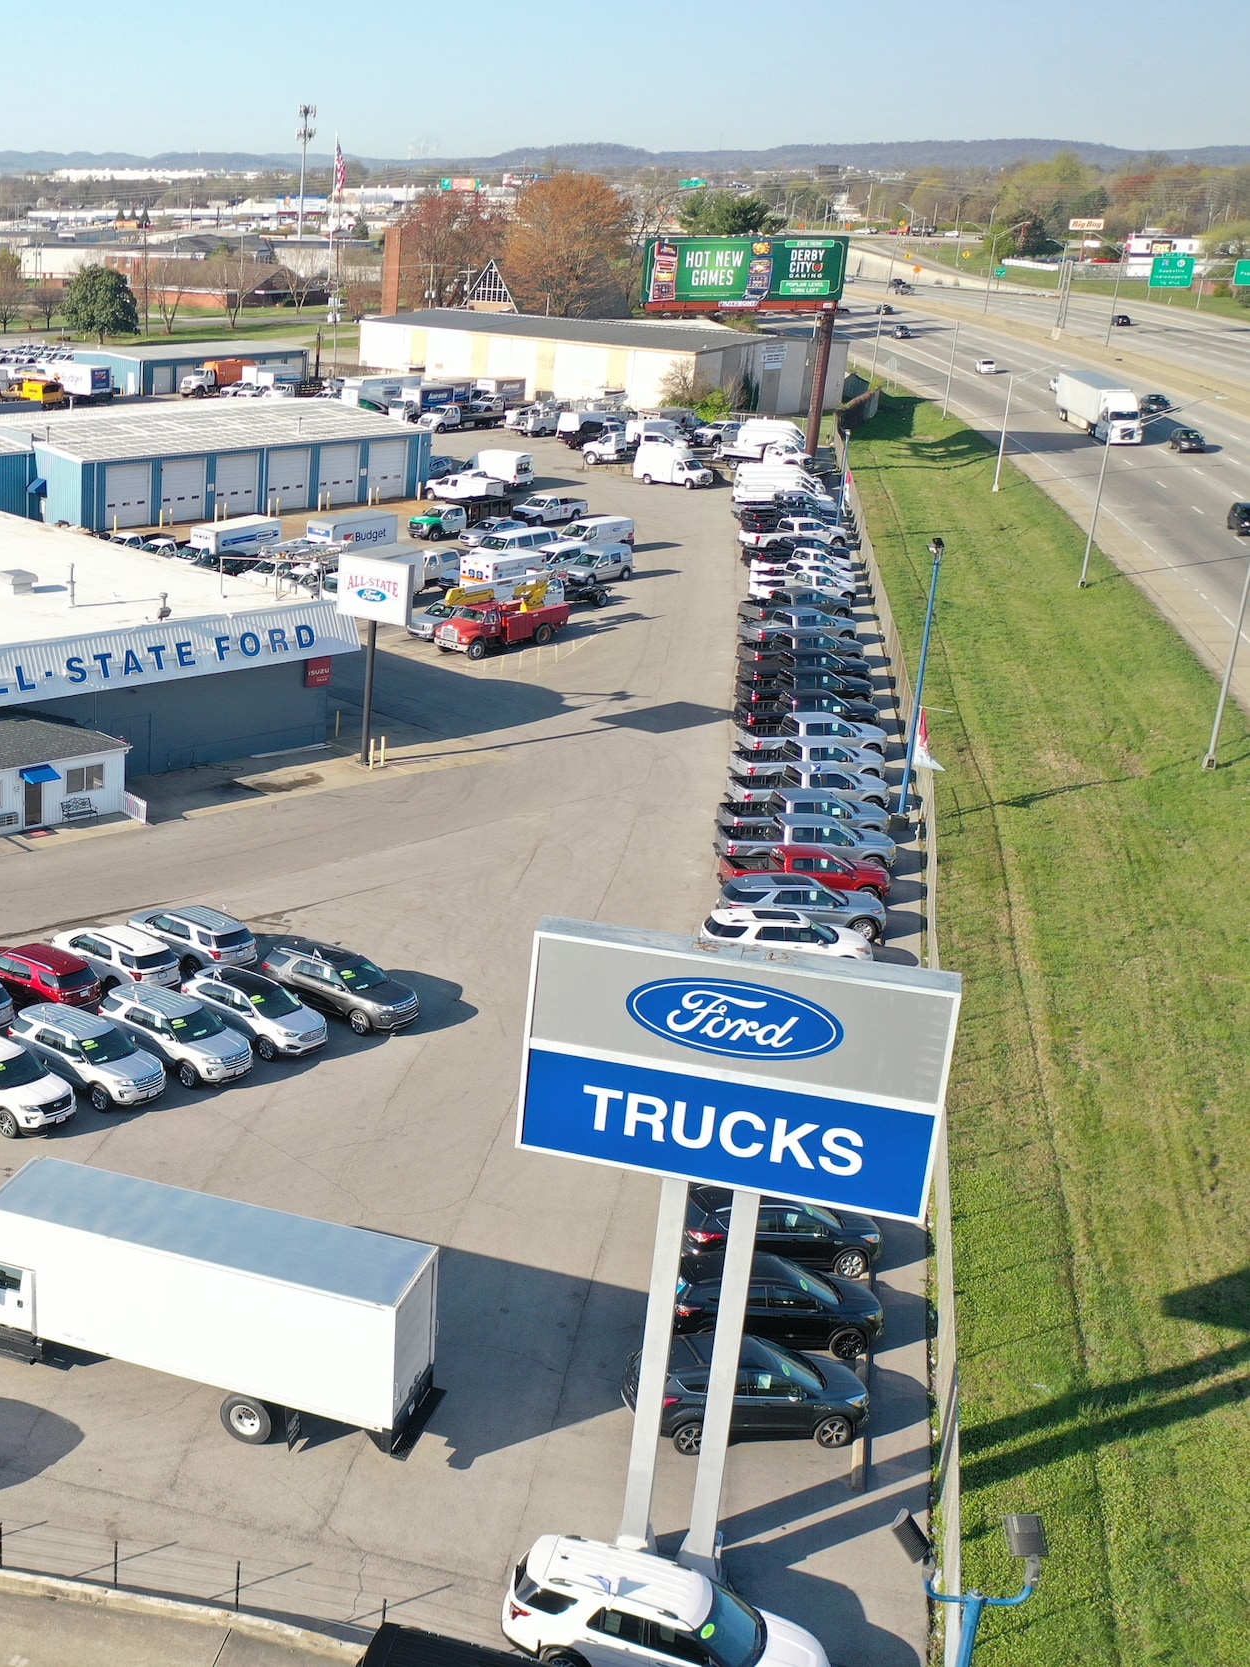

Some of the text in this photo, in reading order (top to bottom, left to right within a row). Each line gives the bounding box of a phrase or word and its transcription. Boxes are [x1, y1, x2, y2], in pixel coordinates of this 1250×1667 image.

[1072, 220, 1102, 230] Big Boy
[685, 250, 744, 268] HOT NEW
[791, 249, 825, 261] DERBY
[789, 261, 812, 273] CITY
[691, 269, 734, 287] GAMES
[355, 528, 386, 543] Budget
[347, 575, 399, 598] ALL-STATE
[361, 589, 383, 600] Ford
[216, 624, 316, 661] FORD
[308, 668, 330, 677] ISUZU
[666, 989, 801, 1048] Ford
[583, 1084, 864, 1177] TRUCKS
